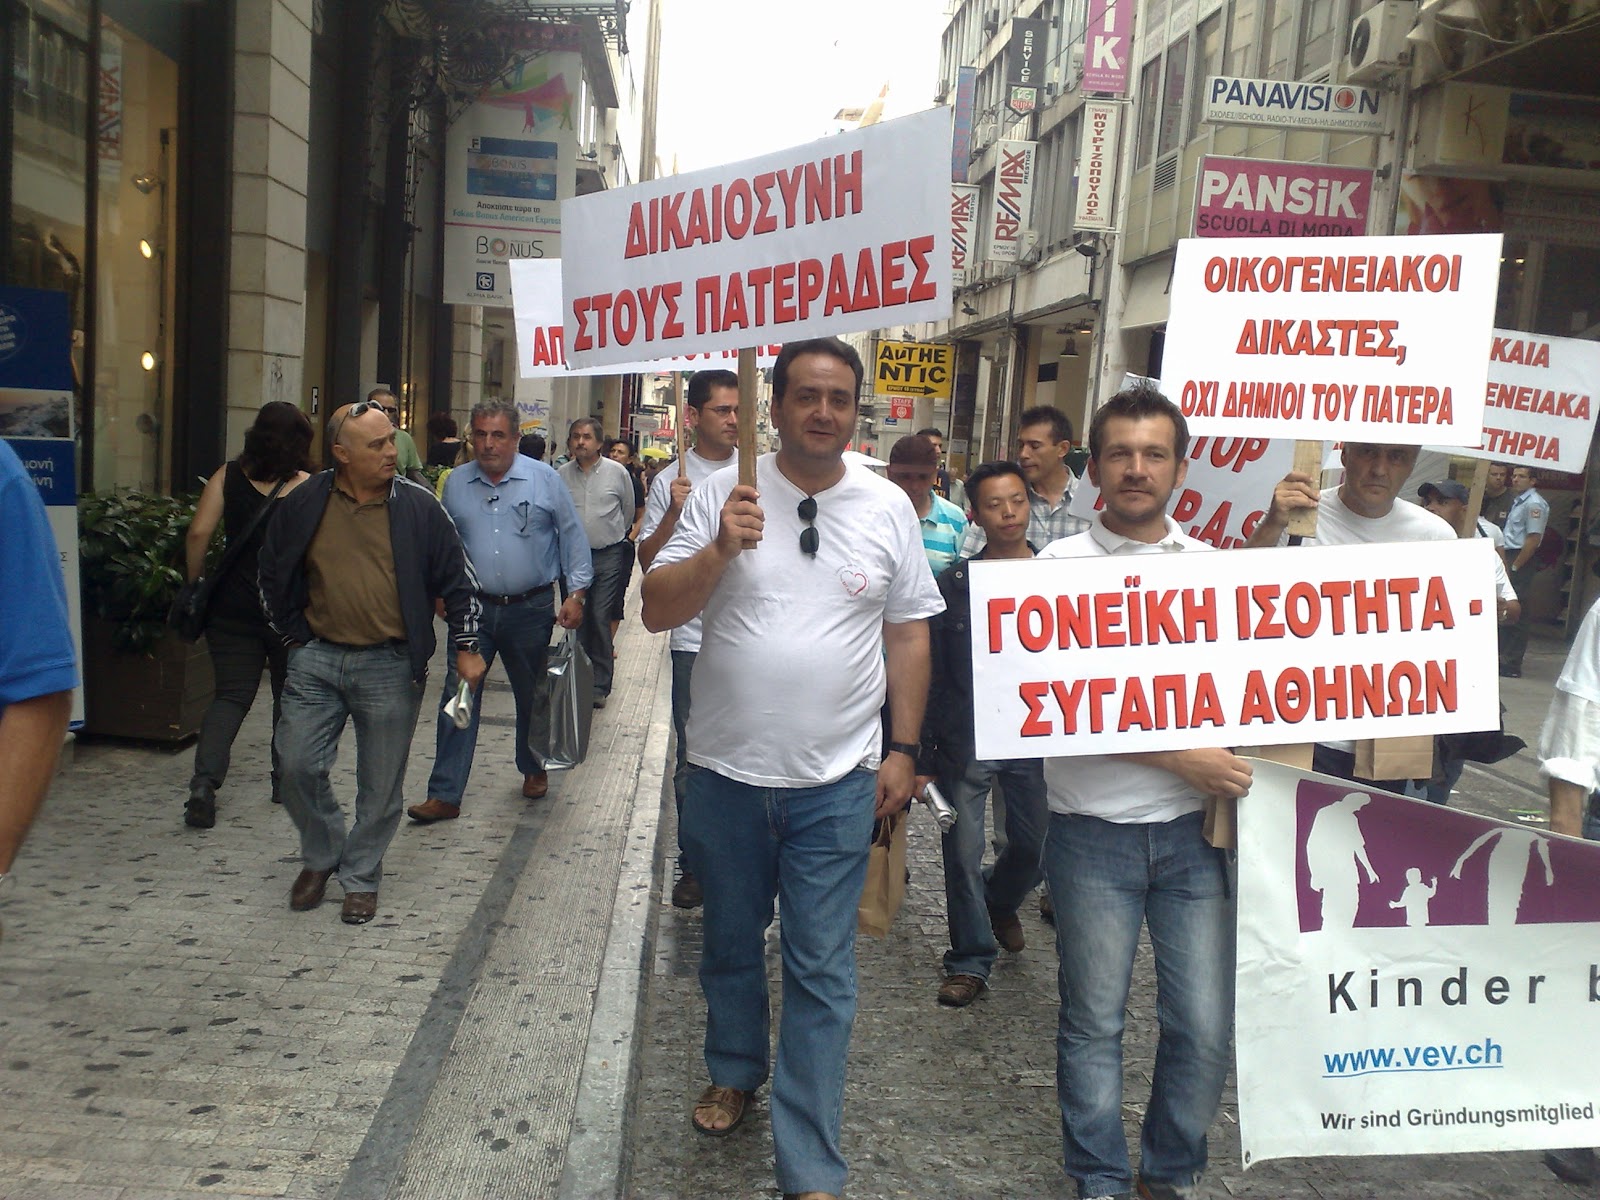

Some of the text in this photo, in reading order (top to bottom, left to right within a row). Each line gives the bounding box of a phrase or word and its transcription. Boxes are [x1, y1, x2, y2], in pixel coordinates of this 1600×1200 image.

[1020, 30, 1034, 83] SERVICE
[1211, 78, 1381, 115] PANAVISION
[1024, 149, 1032, 185] PRESTIGE
[1086, 113, 1107, 215] ΜΟΥΡΤΖΟΠΟΥΛΟΣ
[475, 211, 498, 220] Bonus
[499, 213, 534, 223] American
[624, 149, 863, 260] ΔΙΚΑΙΟΣΥΝΗ
[969, 193, 977, 222] PRESTIGE
[1198, 213, 1354, 236] SCUOLA DI MODA
[476, 235, 544, 259] BONUS
[1204, 253, 1462, 292] ΟΙΚΟΓΕΝΕΙΑΚΟΙ
[573, 235, 938, 353] ΣΤΟΥΣ ΠΑΤΕΡΑΔΕΣ
[1236, 318, 1407, 366] ΔΙΚΑΣΤΕΣ,
[879, 362, 947, 384] NTIC
[1181, 380, 1454, 425] ΟΧΙ ΔΗΜΙΟΙ ΤΟΥ ΠΑΤΕΡΑ
[988, 575, 1218, 653] ΓΟΝΕΪΚΗ
[1236, 576, 1455, 641] ΙΣΟΤΗΤΑ
[1018, 659, 1458, 737] ΣΥΓΑΠΑ ΑΘΗΝΩΝ
[1328, 966, 1546, 1014] Kinder
[1324, 1037, 1503, 1076] www.vev.ch
[1320, 1101, 1595, 1130] Wir sind Gründungsmitglied
